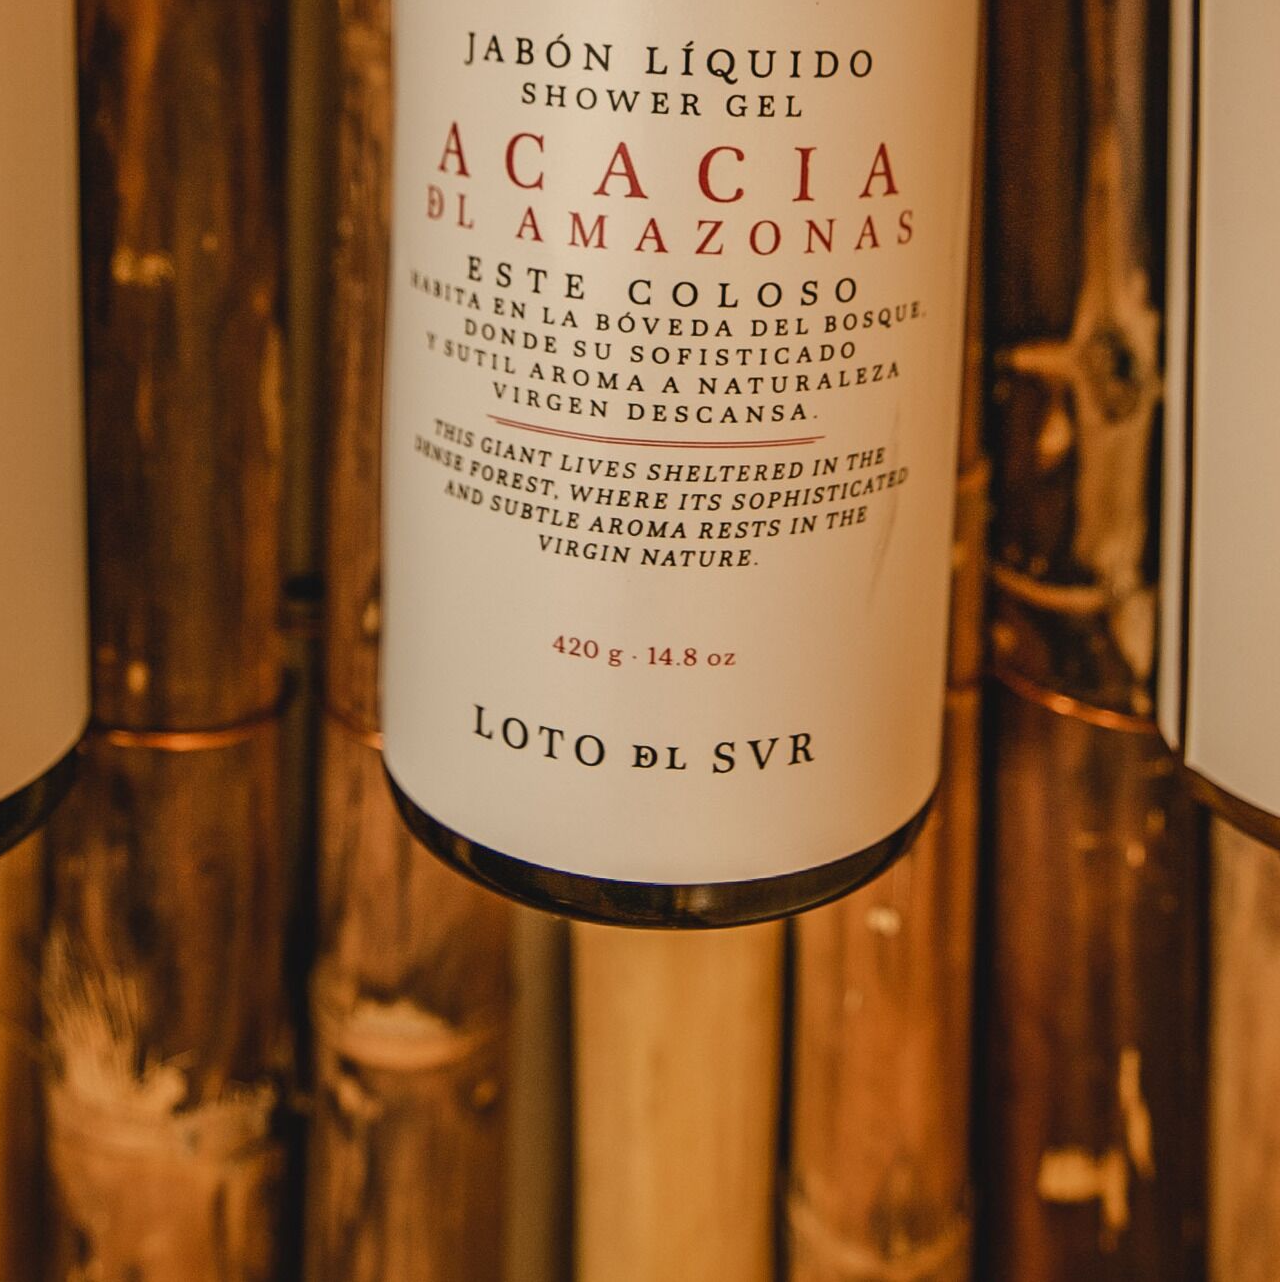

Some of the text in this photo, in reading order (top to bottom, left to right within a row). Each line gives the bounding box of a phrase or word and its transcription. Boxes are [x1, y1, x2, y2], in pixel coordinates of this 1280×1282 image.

[463, 31, 873, 86] JABÓN LÍQUIDO
[521, 81, 803, 118] SHOWER GEL
[437, 120, 900, 204] ACACIA
[515, 205, 913, 257] AMAZONAS
[467, 254, 857, 309] ESTE COLOSO
[464, 317, 856, 367] DONDE SU SOFISTICADO
[493, 296, 527, 320] EN
[541, 306, 579, 329] LA
[595, 311, 734, 338] BÓVEDA
[749, 317, 809, 338] DEL
[444, 339, 516, 375] SUTIL
[528, 362, 645, 393] AROMA
[660, 375, 681, 395] A
[697, 361, 900, 396] NATURALEZA
[492, 381, 818, 424] VIRGEN DESCANSA.
[435, 418, 886, 483] THIS GIANT LIVES SHELTERED IN THE
[444, 479, 868, 540] AND SUBTLE AROMA RESTS IN THE
[469, 459, 559, 501] FOREST,
[569, 483, 669, 510] WHERE
[677, 493, 723, 512] ITS
[731, 466, 909, 511] SOPHISTICATED
[538, 533, 759, 568] VIRGIN NATURE.
[551, 634, 736, 668] 420 g 14.8 oz
[473, 703, 606, 767] LOTO
[711, 732, 816, 774] SVR
